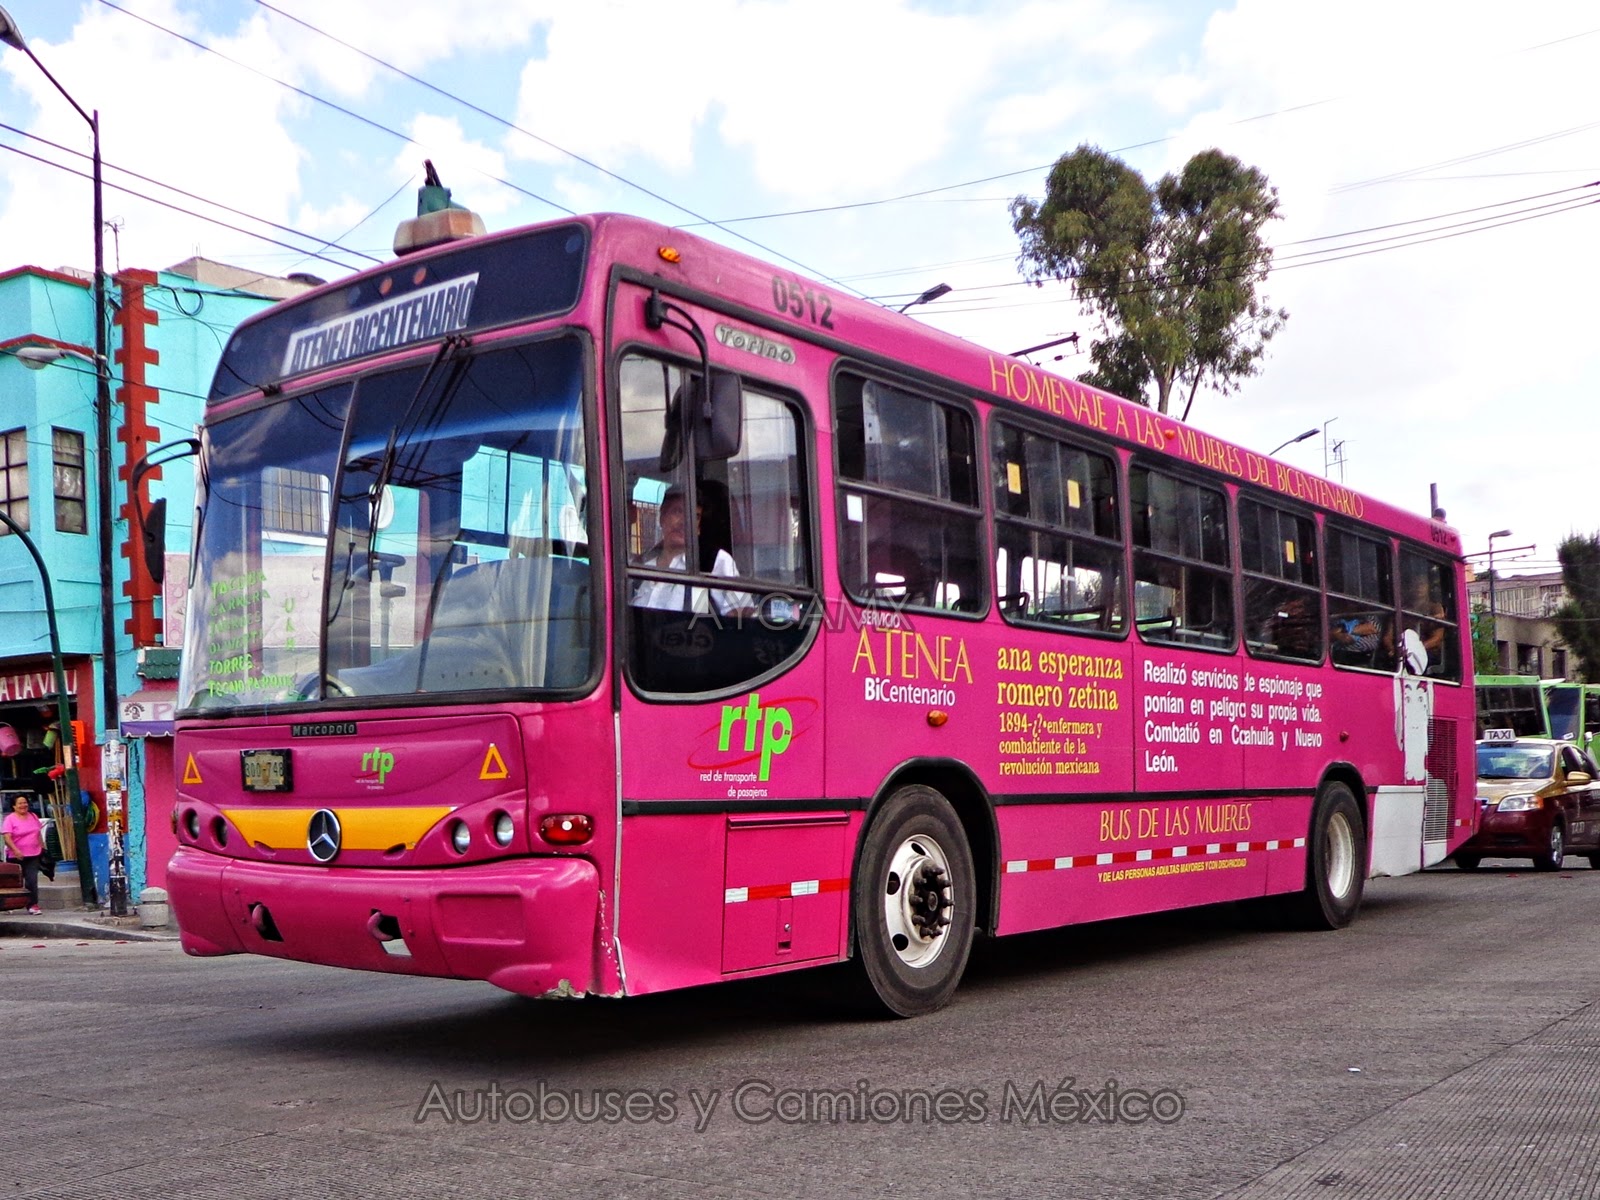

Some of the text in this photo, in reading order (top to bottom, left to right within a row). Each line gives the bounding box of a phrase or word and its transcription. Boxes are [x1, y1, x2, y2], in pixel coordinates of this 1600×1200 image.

[771, 275, 834, 331] 0512
[290, 280, 477, 374] ATENEA BICENTENARIO
[720, 325, 793, 363] Torino
[988, 354, 1364, 519] HOMENAJE A LAS MUJERES DEL BICENTENARIO
[861, 610, 900, 628] SERVICIO
[852, 626, 973, 684] ATENEA
[997, 647, 1123, 682] ana esperanza
[14, 674, 35, 700] LA
[864, 676, 956, 707] BiCentenario
[997, 680, 1119, 710] romero zetina
[1143, 659, 1187, 686] Realizó
[1191, 668, 1239, 690] servicios
[1259, 674, 1303, 700] espionaje
[1305, 683, 1322, 702] que
[1144, 690, 1322, 725] ponían en peligro su propia vida.
[292, 723, 356, 737] Marcopolo
[718, 693, 793, 781] rtp
[1096, 722, 1102, 739] y
[1144, 720, 1322, 751] Combatió en Coahuila y Nuevo
[1487, 730, 1513, 741] TAXI
[999, 737, 1087, 755] combatiente de la
[1145, 749, 1179, 772] León.
[362, 747, 395, 785] rtp
[700, 770, 758, 784] red de transporte
[999, 757, 1100, 775] revolución mexicana
[728, 786, 768, 799] de pasajeros
[1100, 803, 1252, 842] BUS DE LAS MUJERES
[1098, 873, 1103, 882] Y
[1103, 872, 1112, 882] DE
[1112, 870, 1124, 881] LAS
[1125, 867, 1156, 880] PERSONAS
[1156, 864, 1180, 877] ADULTAS
[1181, 861, 1205, 873] MAYORES
